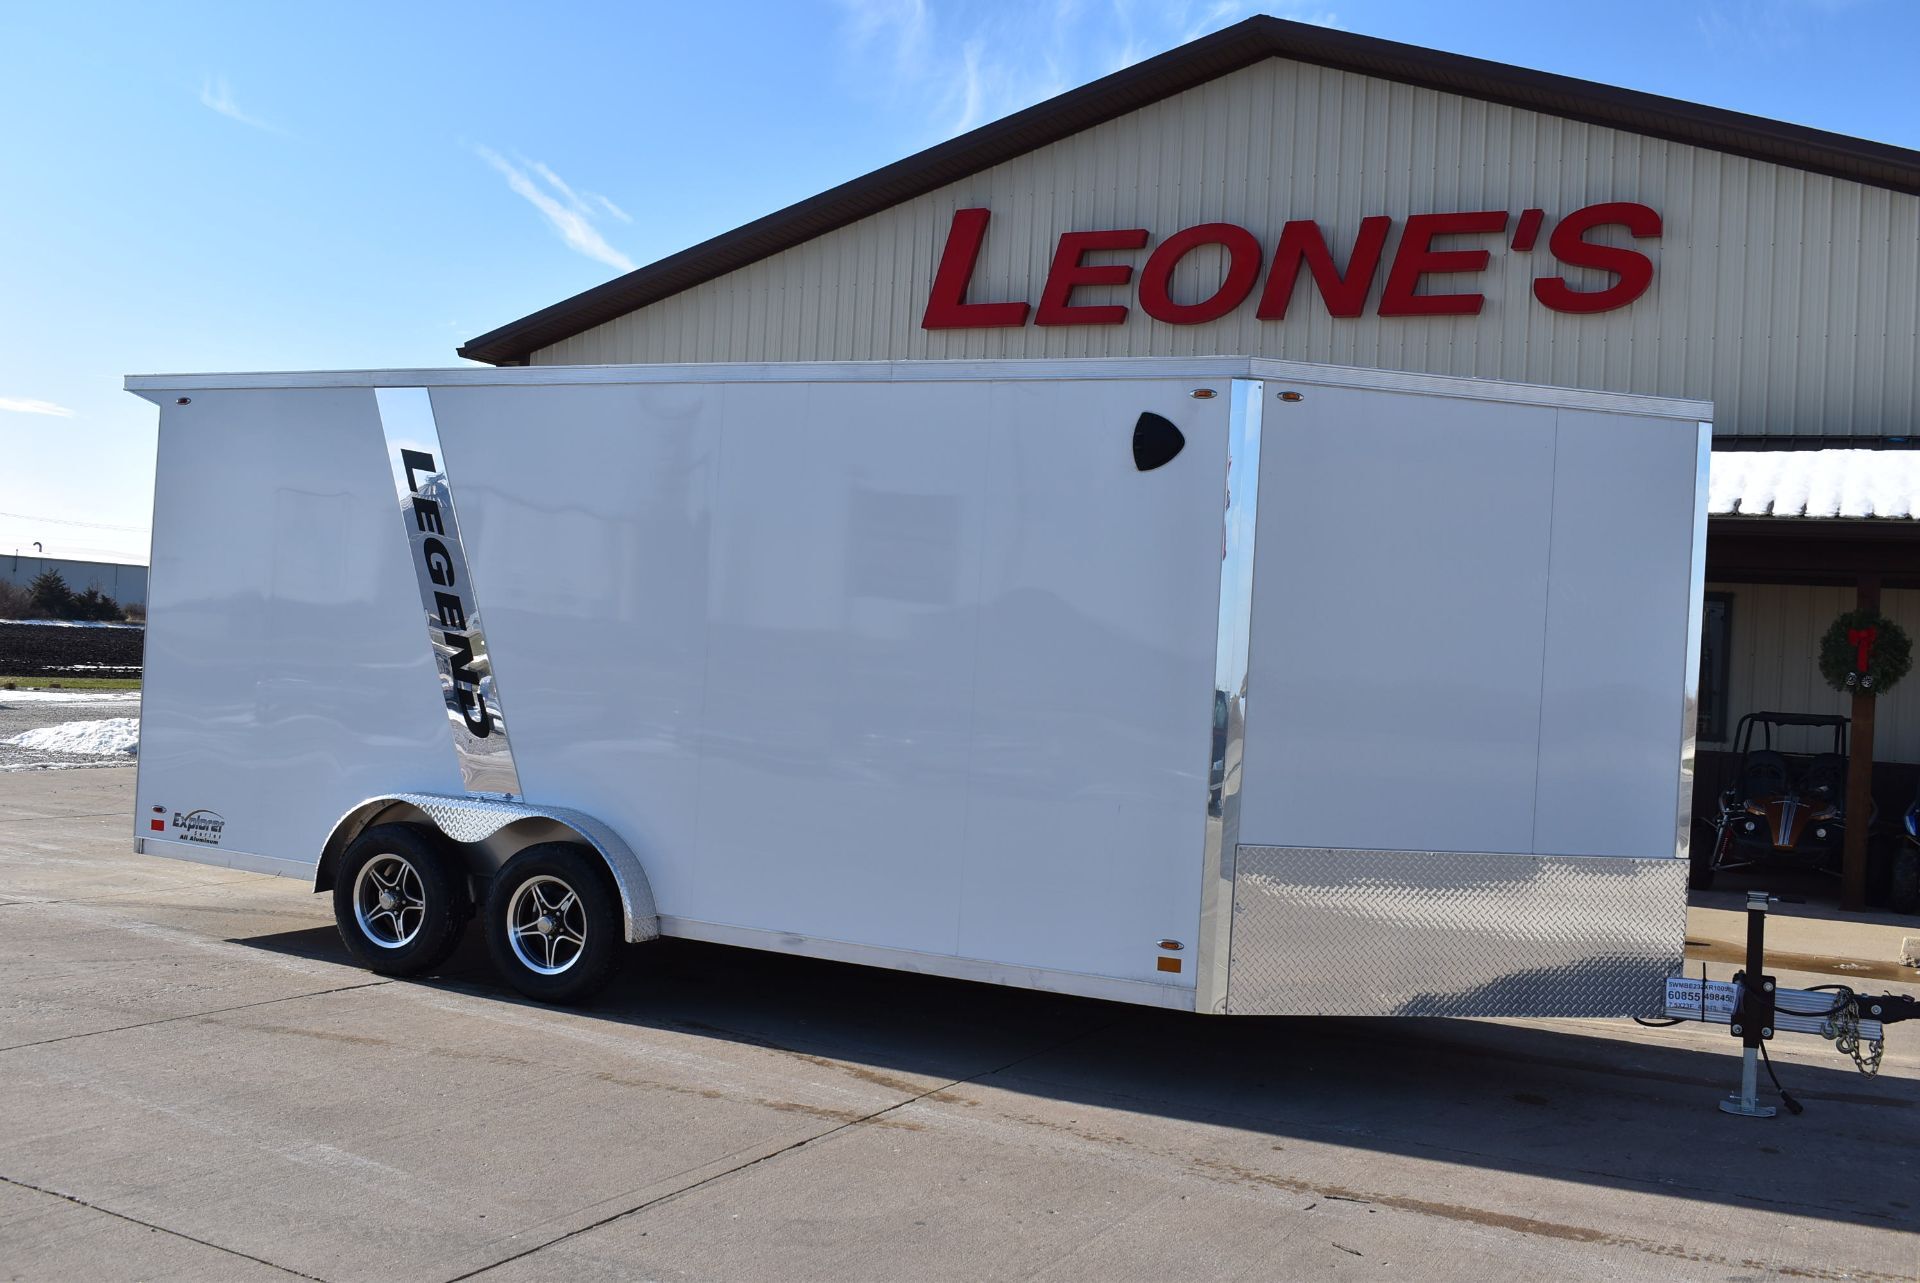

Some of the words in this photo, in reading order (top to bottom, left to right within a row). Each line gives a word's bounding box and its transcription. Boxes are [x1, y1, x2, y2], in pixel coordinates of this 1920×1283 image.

[921, 202, 1662, 329] LEONE'S
[401, 448, 490, 739] LEGEND
[172, 812, 225, 832] Explorer
[189, 836, 219, 845] Aluminum
